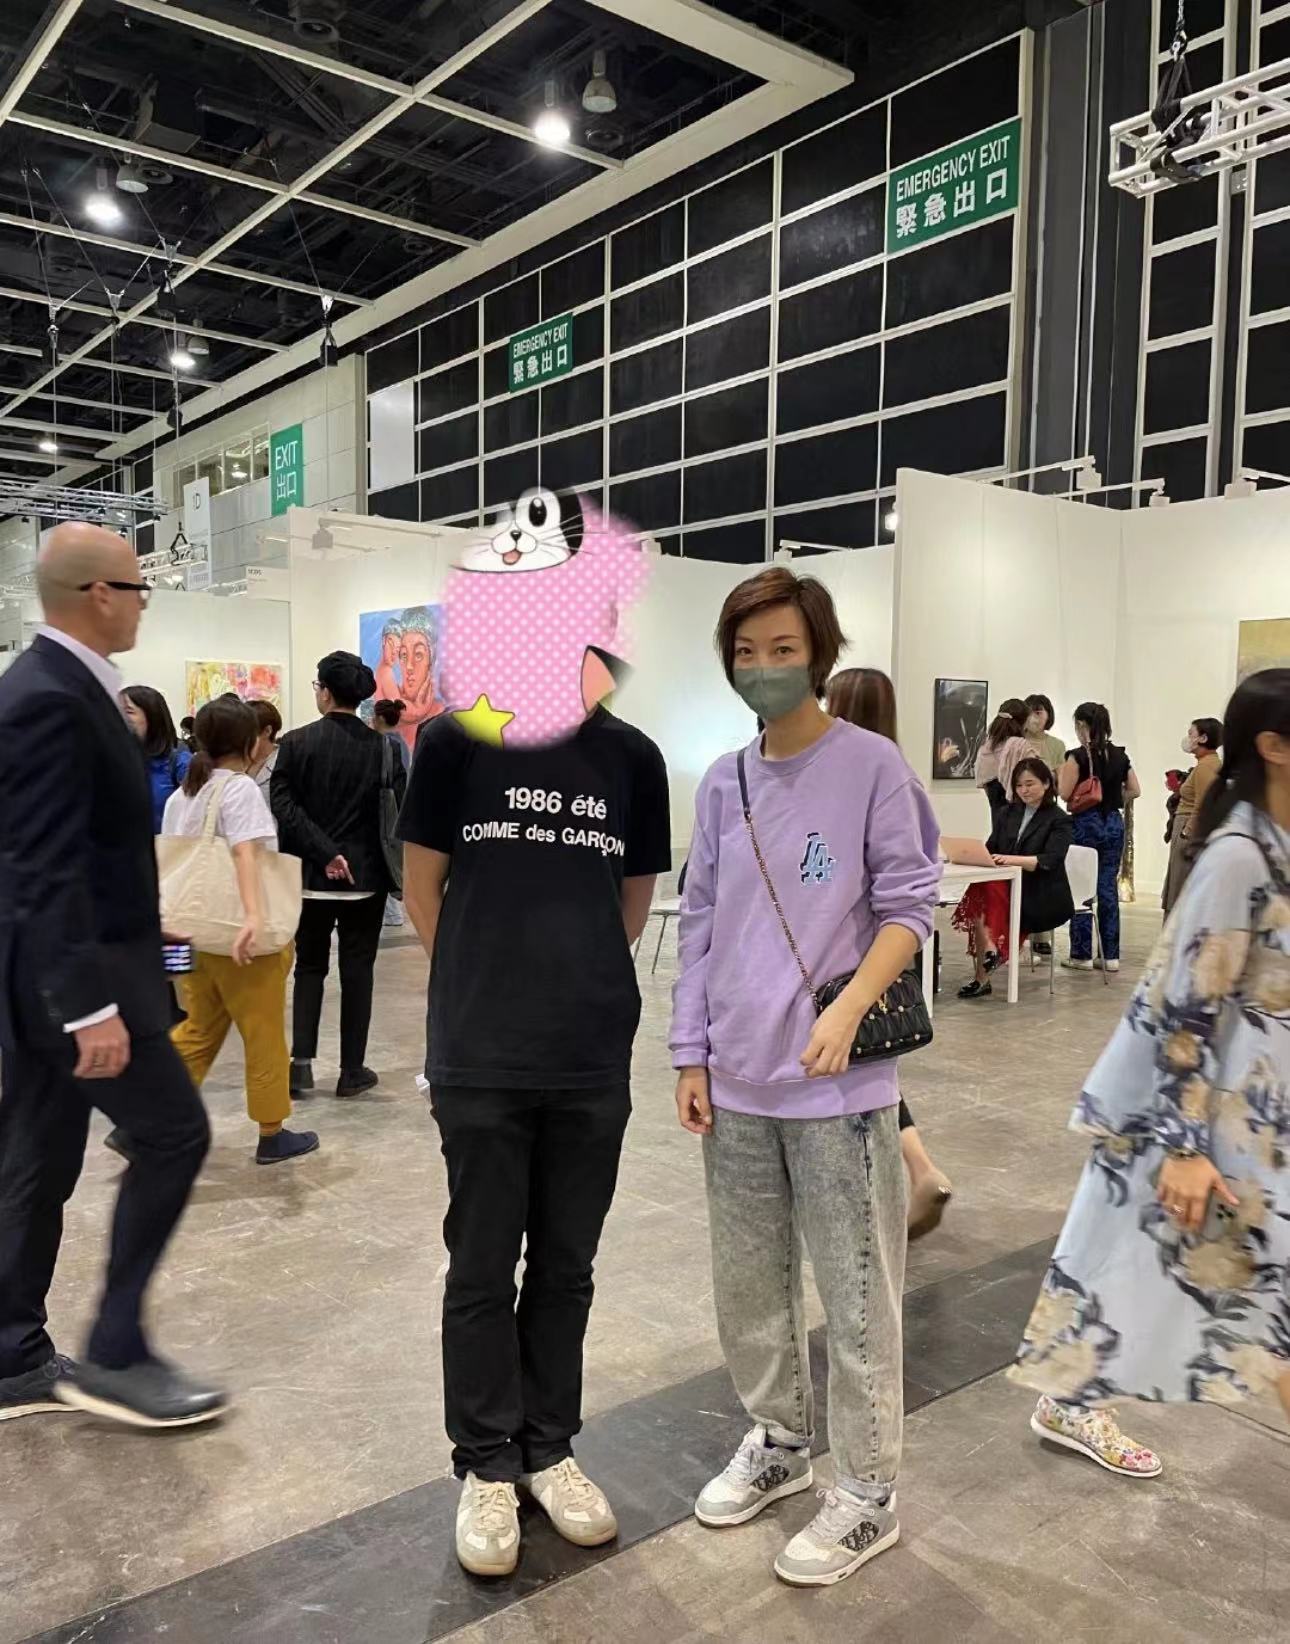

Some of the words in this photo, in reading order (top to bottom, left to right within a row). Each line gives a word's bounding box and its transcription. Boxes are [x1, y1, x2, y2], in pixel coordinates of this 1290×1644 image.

[896, 148, 977, 202] EMERGENCY
[979, 135, 1011, 168] EXIT
[896, 168, 1008, 239] 緊急出口
[513, 329, 553, 359] EMERGENCY
[553, 322, 568, 343] EXIT
[513, 344, 568, 385] 緊急出口
[275, 440, 298, 471] EXIT
[276, 471, 297, 501] 出口
[504, 787, 562, 814] 1986
[570, 794, 608, 820] été
[462, 821, 520, 842] COMME
[525, 824, 556, 842] des
